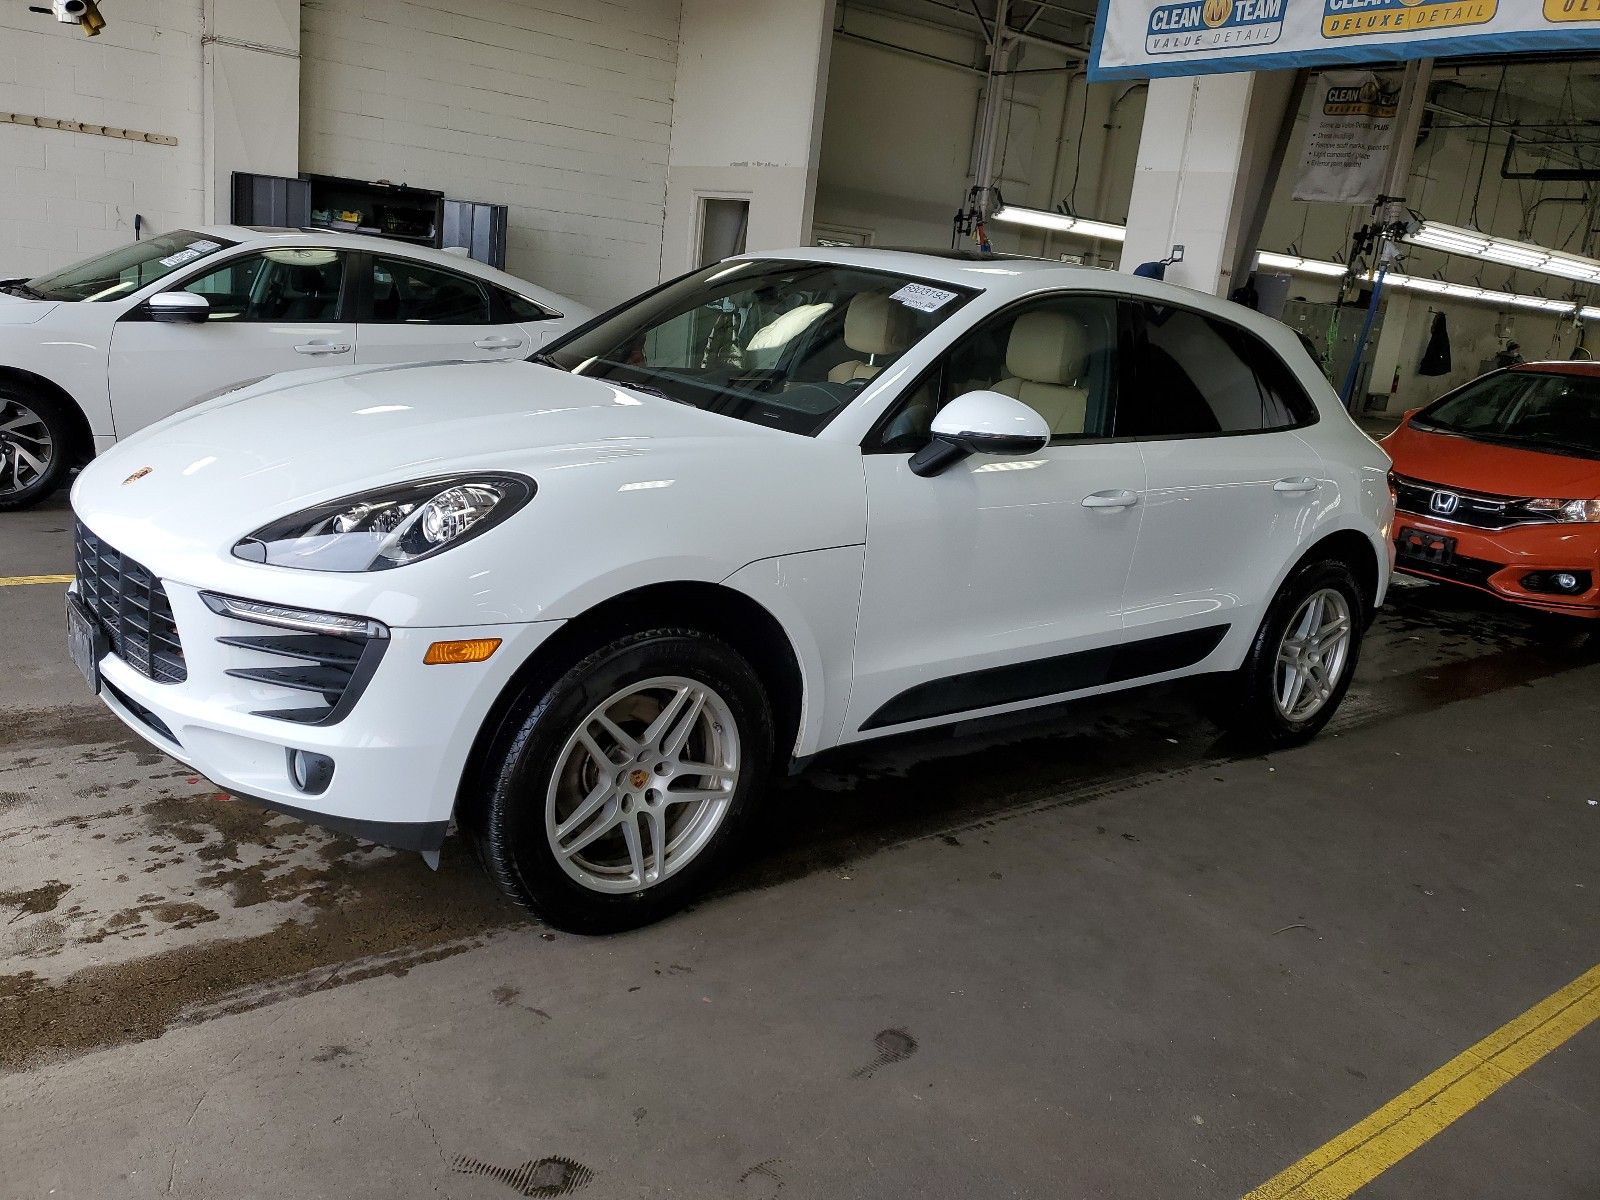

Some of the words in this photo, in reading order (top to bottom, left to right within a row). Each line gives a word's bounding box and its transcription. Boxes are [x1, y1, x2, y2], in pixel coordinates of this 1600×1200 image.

[1151, 6, 1202, 31] CLEAN
[1235, 0, 1282, 22] TEAM
[1563, 0, 1600, 12] UL
[1330, 13, 1405, 32] DELUXE
[1416, 5, 1485, 24] DETAIL
[1153, 34, 1202, 49] VALUE
[1213, 28, 1270, 44] DETAIL
[1328, 89, 1360, 102] CLEAN
